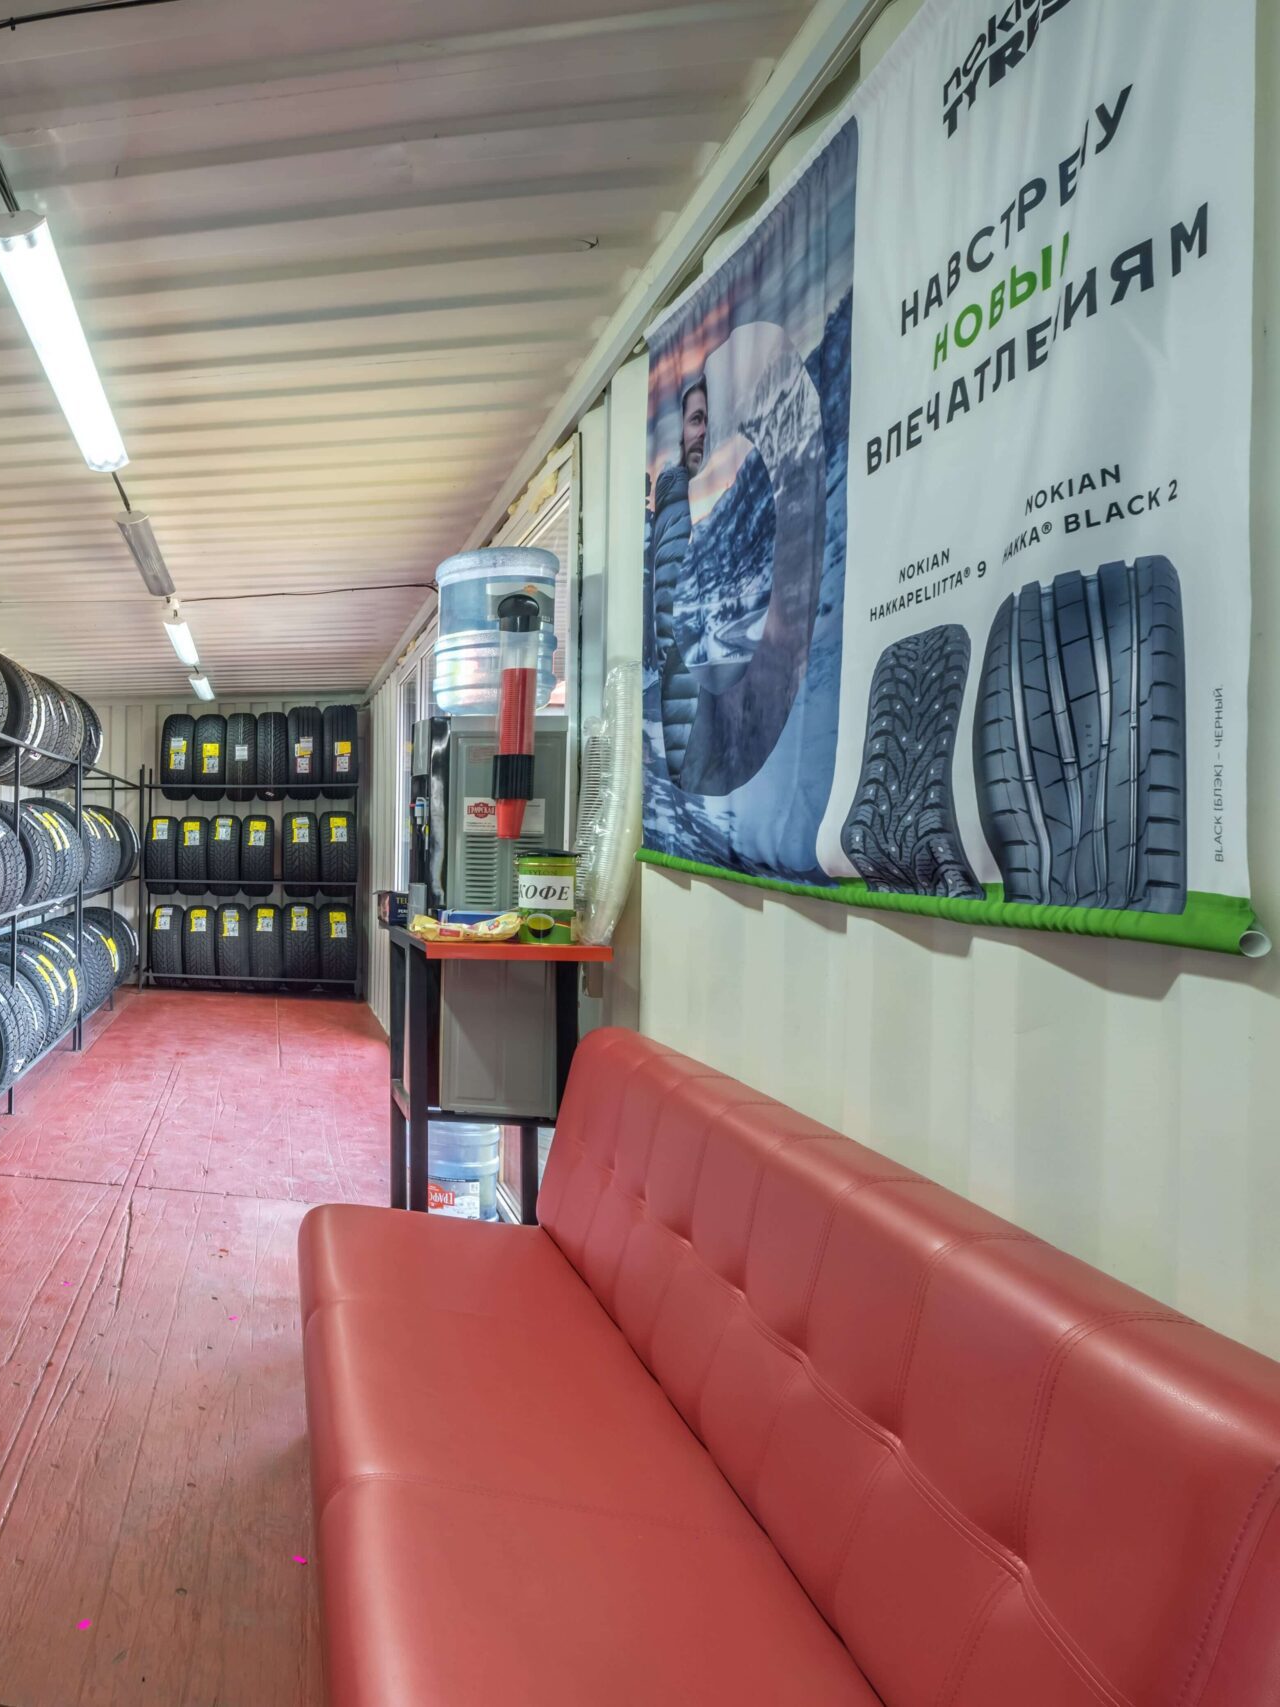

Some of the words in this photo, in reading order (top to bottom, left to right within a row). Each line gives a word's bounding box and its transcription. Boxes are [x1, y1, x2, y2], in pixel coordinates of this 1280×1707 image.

[901, 83, 1134, 337] НАВСТРЕУ
[933, 231, 1070, 371] НОВЫ
[867, 202, 1209, 476] ВПЕЧАТЛЕИЯМ
[1024, 464, 1121, 516] NOKIAN
[1063, 487, 1161, 534] BLACK
[1167, 479, 1178, 502] 2
[898, 548, 950, 584] NOKIAN
[976, 560, 987, 578] 9
[1213, 816, 1224, 863] BLACK
